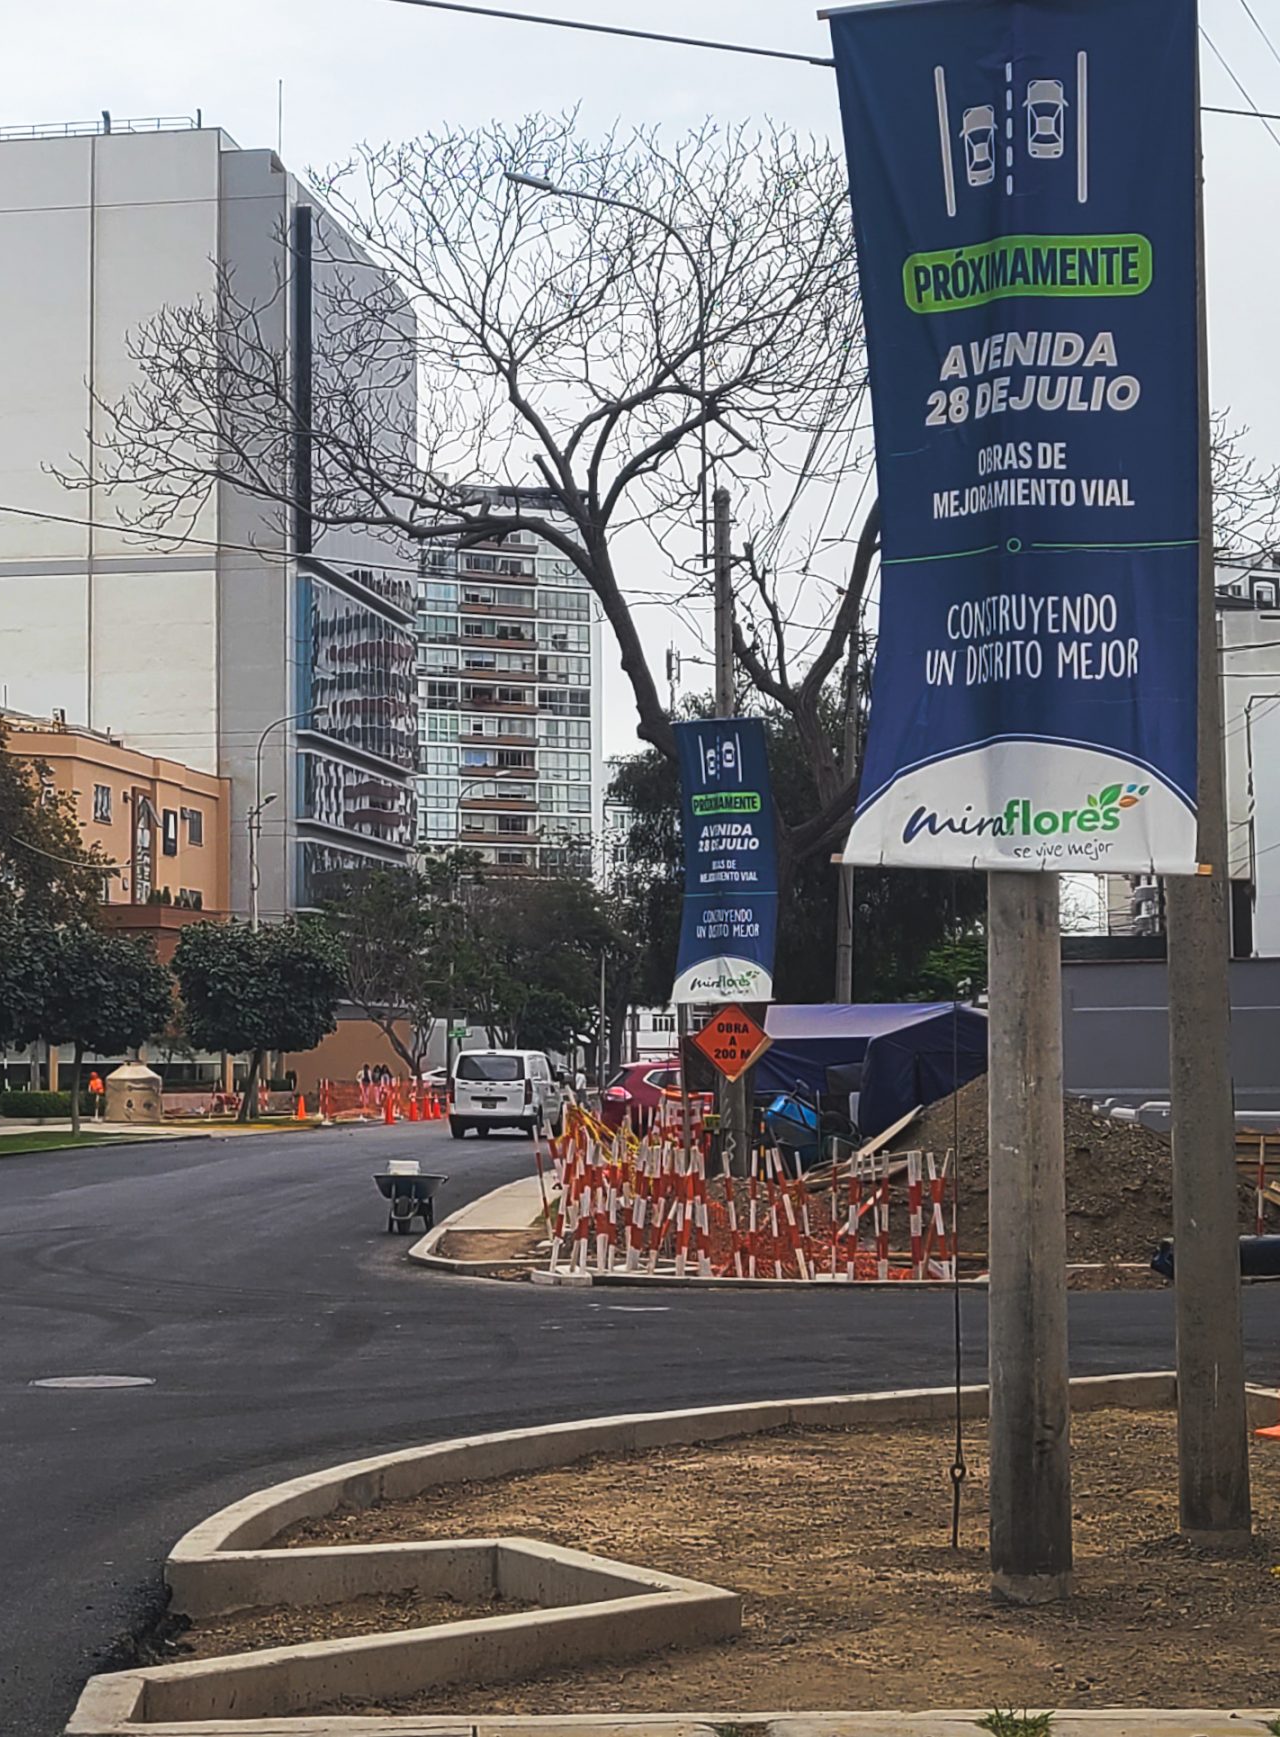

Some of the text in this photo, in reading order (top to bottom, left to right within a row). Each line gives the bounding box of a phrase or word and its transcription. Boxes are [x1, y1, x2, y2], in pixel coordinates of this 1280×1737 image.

[914, 245, 1140, 304] PRÓXIMAMENTE
[940, 331, 1118, 382] AVENIDA
[925, 375, 1141, 426] 28 DE JULIO
[978, 441, 1067, 476] OBRAS DE
[933, 478, 1135, 519] MEJORAMIENTO VIAL
[947, 593, 1118, 640] CONSTRUYENDO
[925, 638, 1140, 687] UN DISTRITO MEJOR
[902, 799, 1121, 844] miraflores
[698, 839, 710, 852] 28
[718, 837, 759, 850] JULIO
[1013, 839, 1115, 860] se vive mejor
[733, 923, 759, 938] MEJOR
[717, 1022, 749, 1034] OBRA
[729, 1035, 737, 1046] A
[714, 1048, 752, 1059] 200 M
